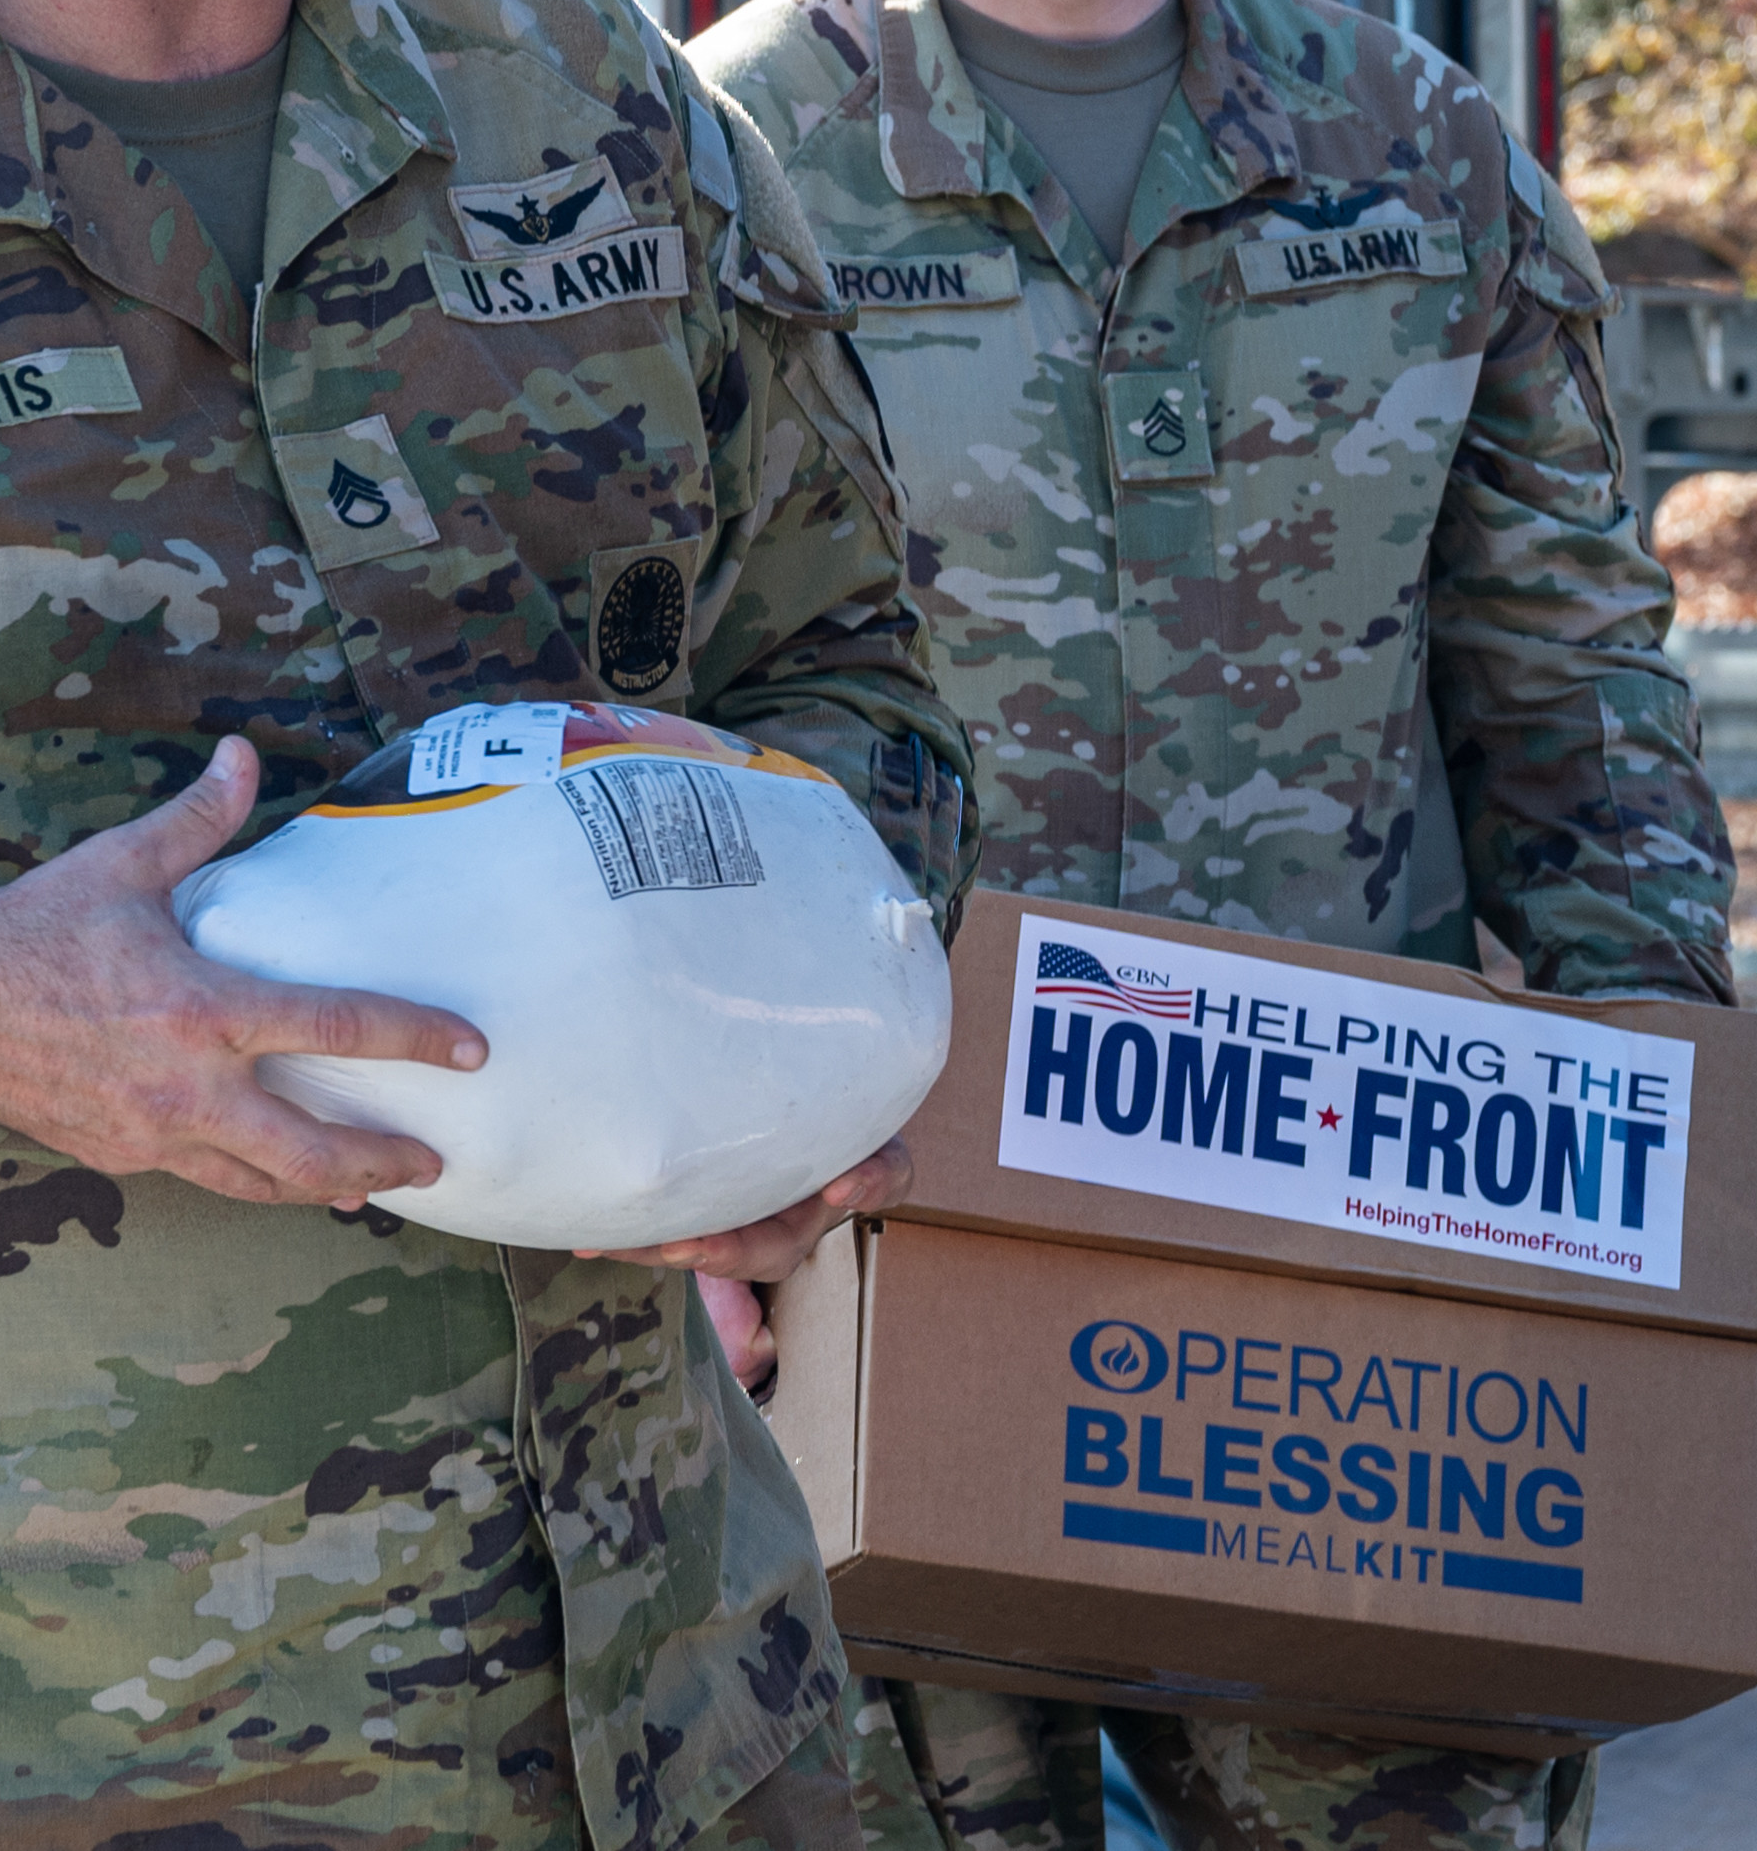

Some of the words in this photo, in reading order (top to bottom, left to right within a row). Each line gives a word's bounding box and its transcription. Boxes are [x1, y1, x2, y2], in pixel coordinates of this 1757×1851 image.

[461, 267, 549, 315] U.S.
[552, 238, 659, 307] ARMY
[1282, 242, 1342, 281] U.S.
[1342, 229, 1420, 272] ARMY
[611, 659, 671, 690] INSTRUCTOR
[483, 739, 523, 757] F
[563, 779, 591, 816] Facts
[587, 819, 622, 894] Nutrition
[1116, 965, 1170, 988] CBN
[1193, 987, 1507, 1085] HELPING
[1534, 1050, 1669, 1117] THE
[1023, 1005, 1313, 1168] HOME
[1348, 1066, 1666, 1230] FRONT
[1345, 1196, 1642, 1273] HelpingTheHomeFront.org
[1069, 1319, 1588, 1454] OPERATION
[1063, 1405, 1585, 1548] BLESSING
